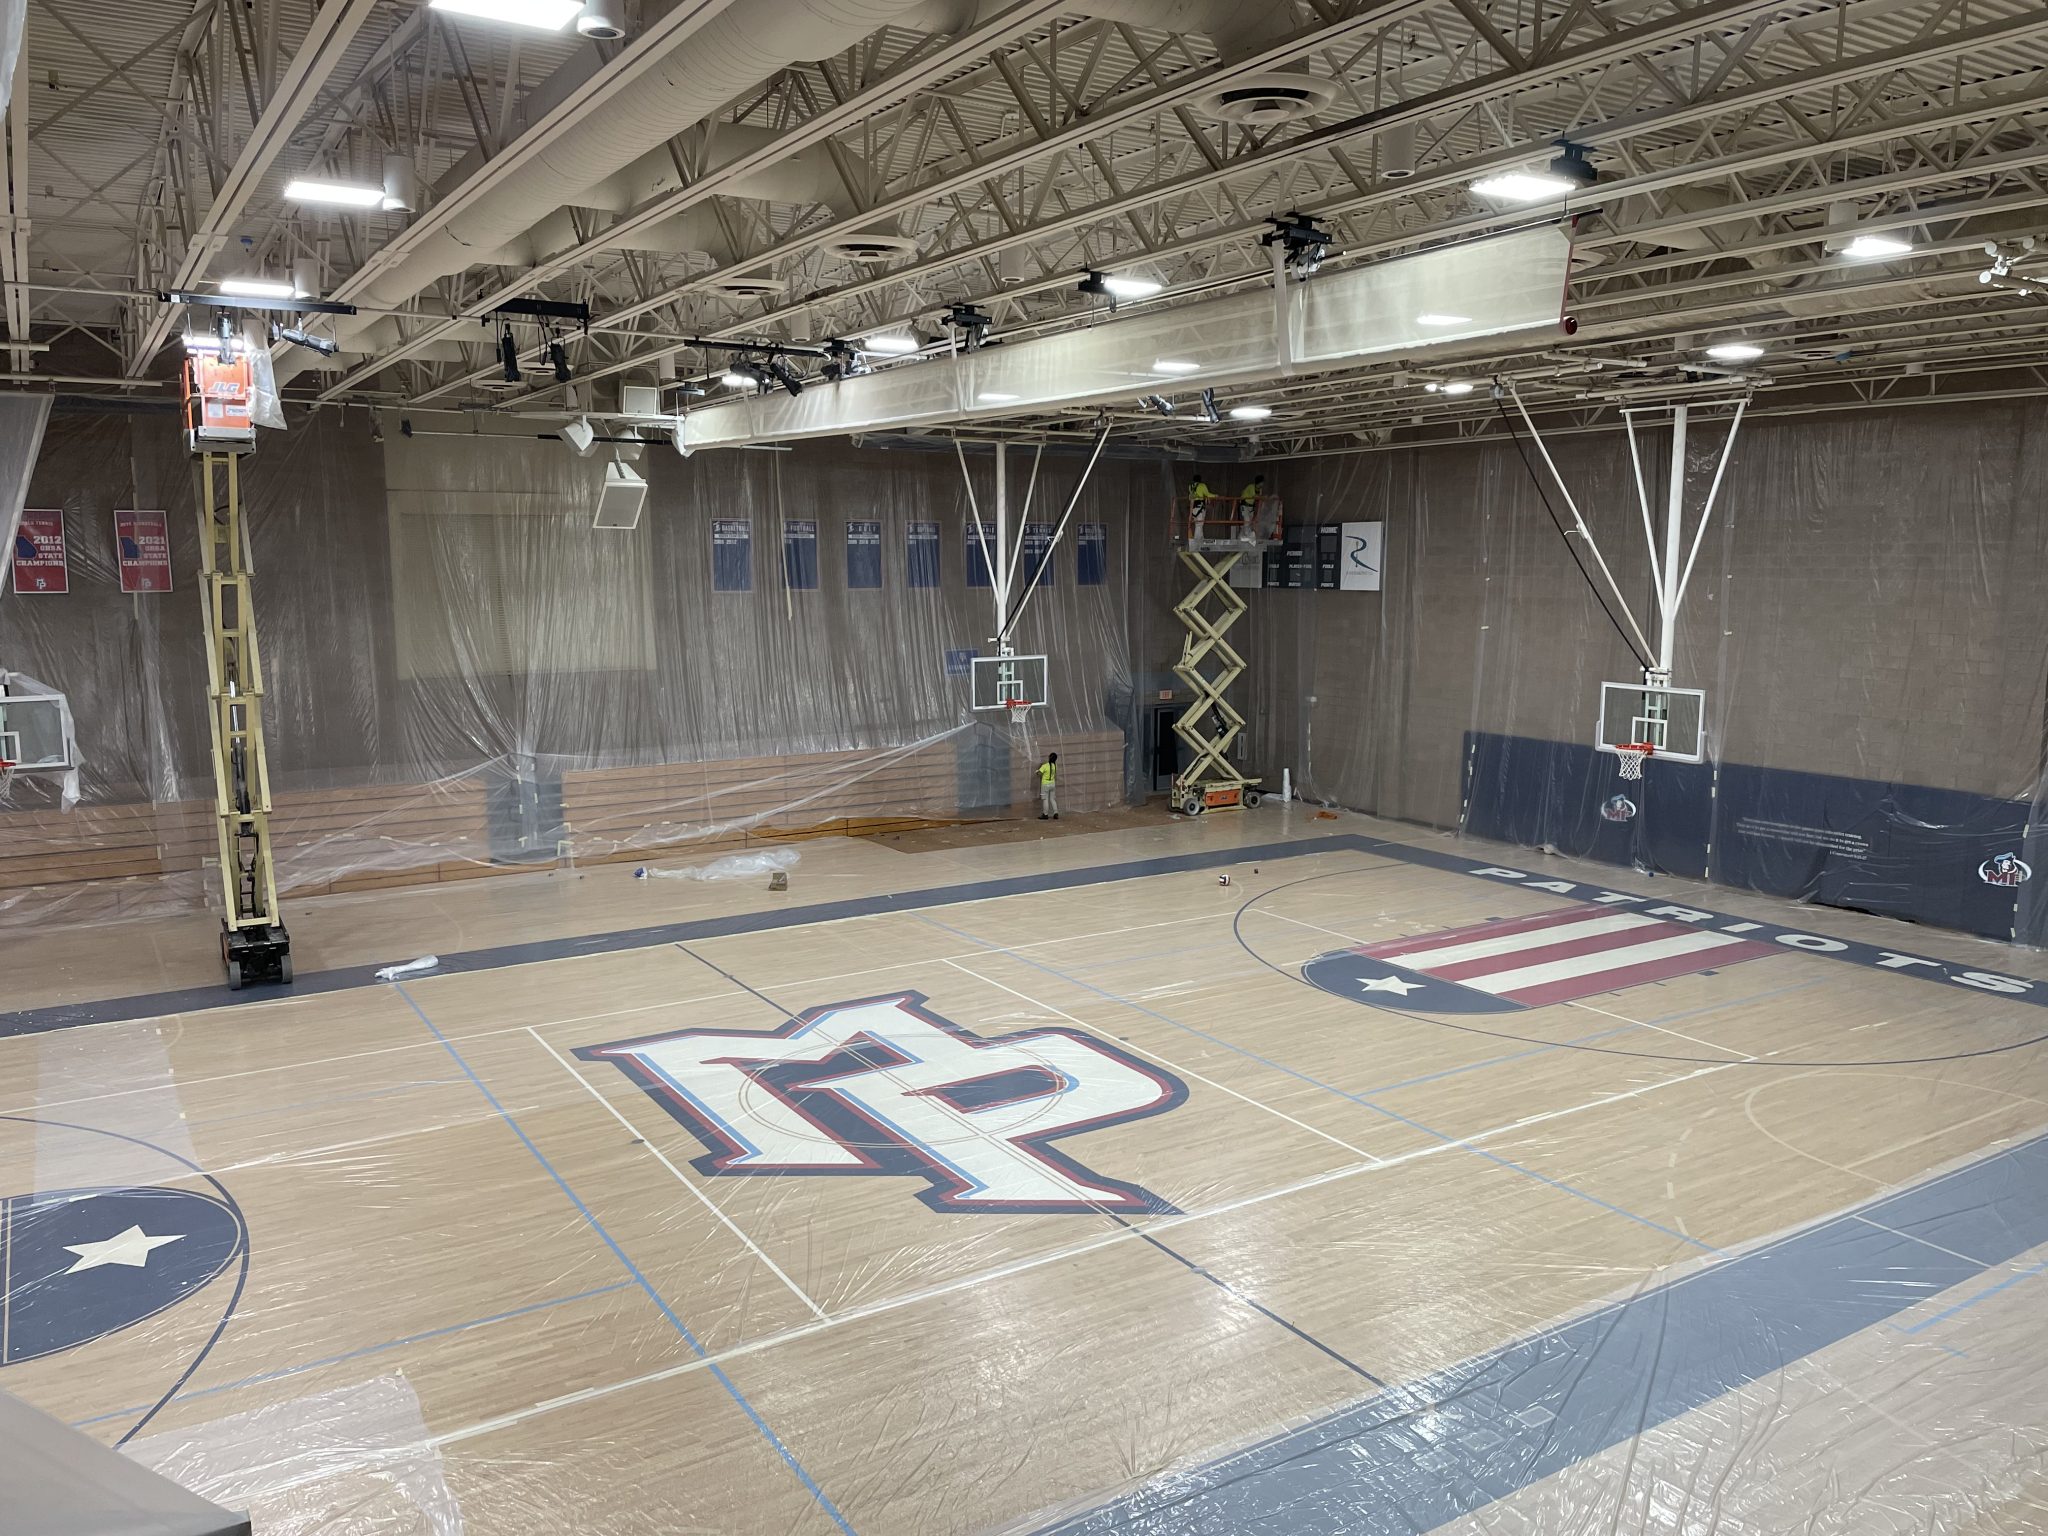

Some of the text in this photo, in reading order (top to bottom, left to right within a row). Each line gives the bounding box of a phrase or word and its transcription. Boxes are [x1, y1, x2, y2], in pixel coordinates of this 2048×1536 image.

[208, 381, 241, 394] JLG
[33, 535, 62, 545] 2012
[138, 535, 165, 545] 2021
[1468, 867, 2035, 994] PATRIOTS
